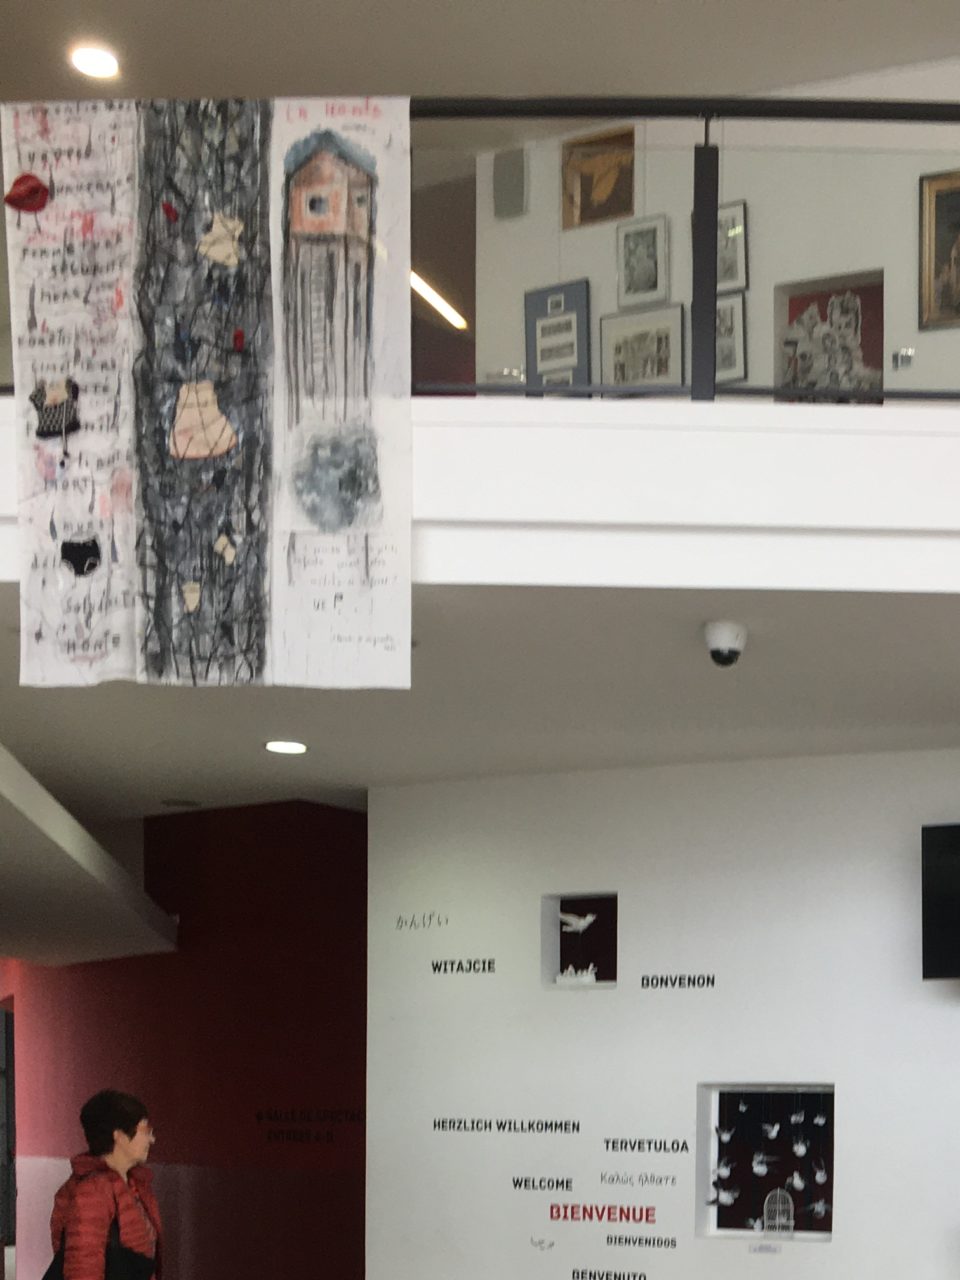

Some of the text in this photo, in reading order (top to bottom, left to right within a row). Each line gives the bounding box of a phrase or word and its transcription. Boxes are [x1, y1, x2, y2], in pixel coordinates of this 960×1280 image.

[432, 959, 495, 974] WITAJCIE
[641, 974, 715, 989] BONVENON
[433, 1118, 580, 1133] HERZLICH WILLKOMMEN
[604, 1138, 689, 1153] TERVETULOA
[512, 1177, 572, 1191] WELCOME
[550, 1203, 656, 1224] BIENVENUE
[607, 1235, 676, 1248] BIENVENIDOS
